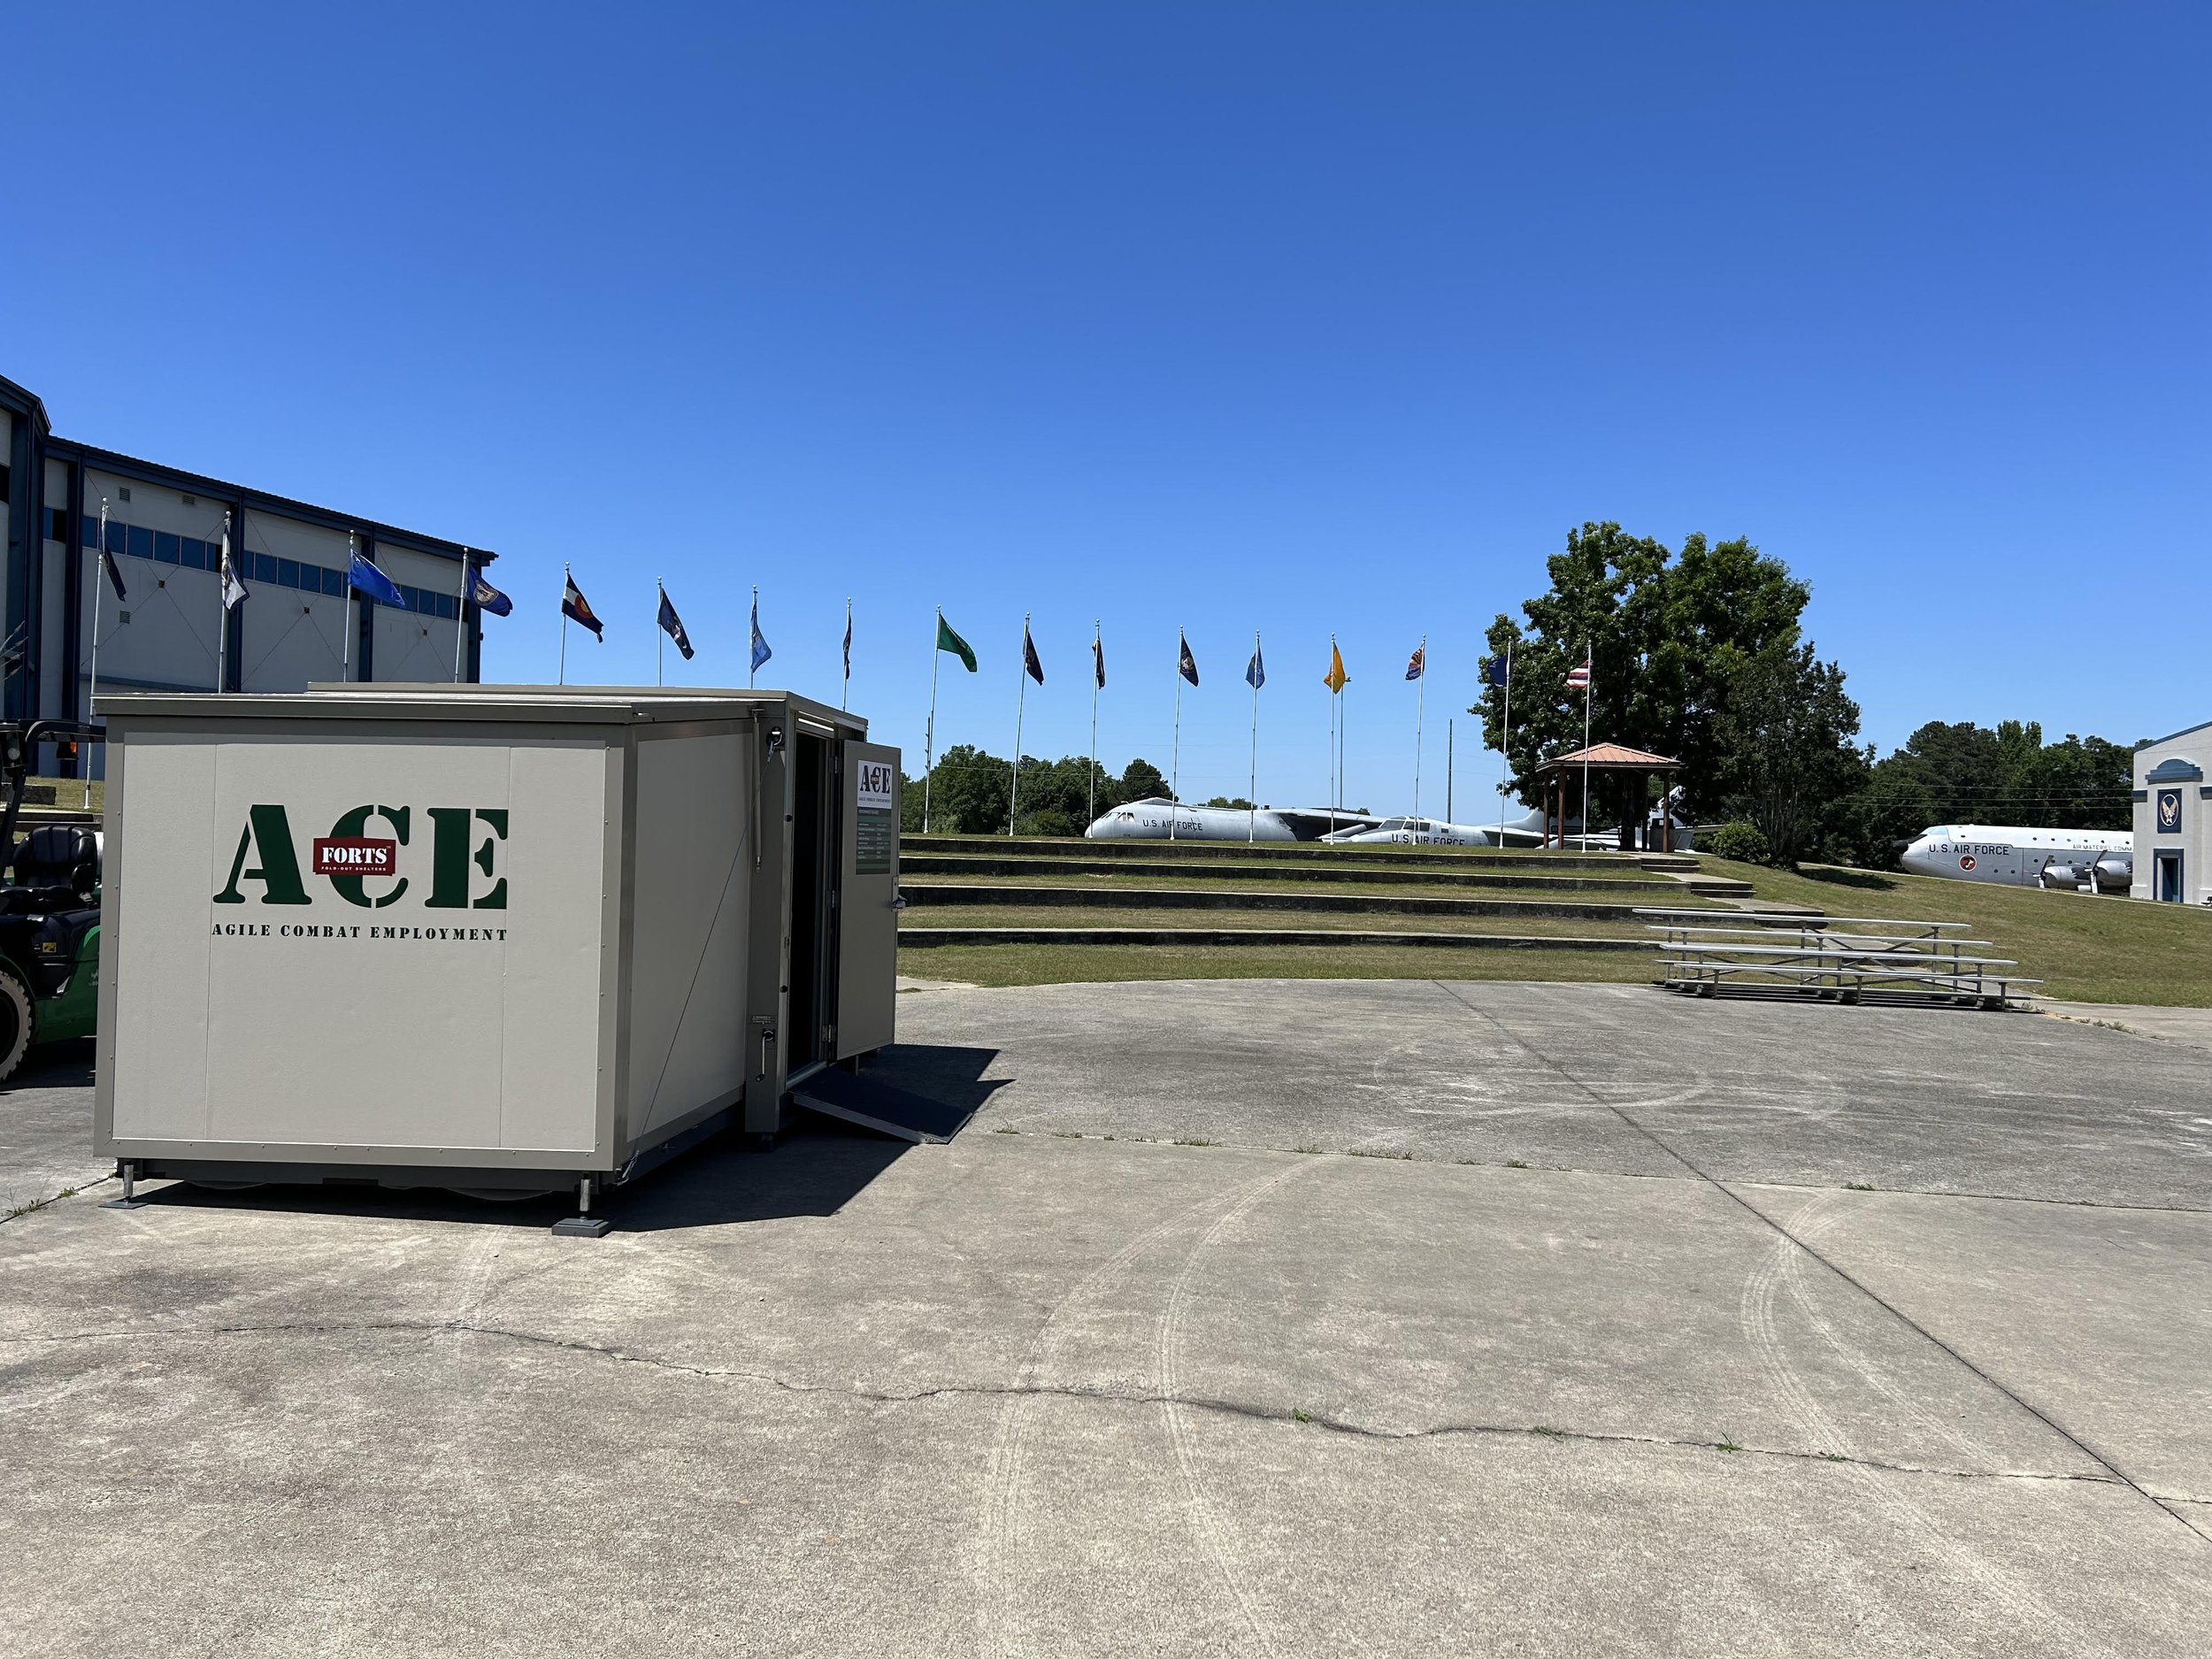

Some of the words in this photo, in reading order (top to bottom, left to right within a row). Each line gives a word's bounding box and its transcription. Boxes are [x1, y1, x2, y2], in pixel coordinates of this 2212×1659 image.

[860, 764, 890, 794] ACE
[1177, 821, 1202, 832] FORCE
[212, 804, 509, 909] ACE
[321, 847, 387, 864] FORTS
[1929, 844, 1951, 853] U.S.
[1954, 844, 1970, 854] AIR
[1974, 845, 2009, 856] FORCE
[211, 924, 271, 936] AGILE
[280, 925, 360, 938] COMBAT
[370, 926, 507, 941] EMPLOYMENT
